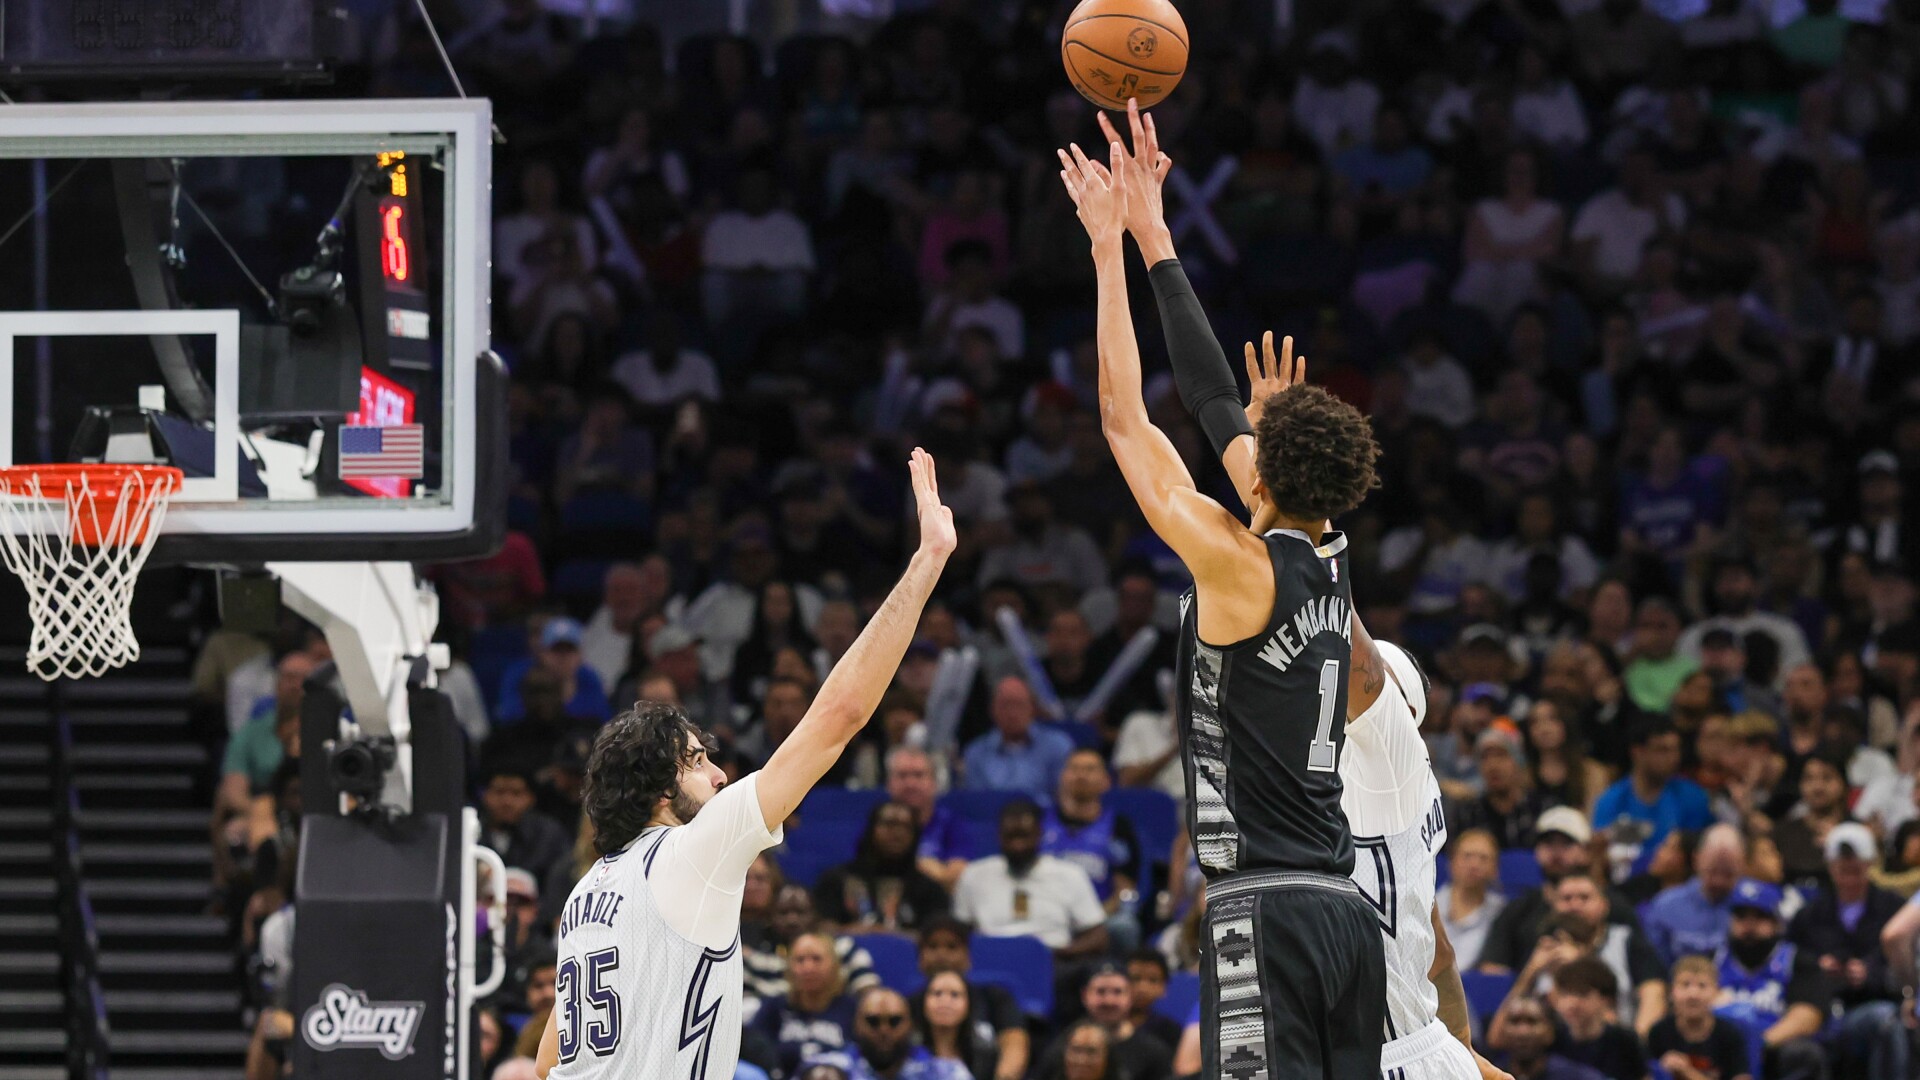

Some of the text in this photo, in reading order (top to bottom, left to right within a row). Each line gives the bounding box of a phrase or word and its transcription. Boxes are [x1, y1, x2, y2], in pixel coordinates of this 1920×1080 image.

[1306, 658, 1340, 773] 1
[561, 891, 624, 939] BITADZE
[304, 987, 421, 1057] Starry
[556, 945, 622, 1065] 35
